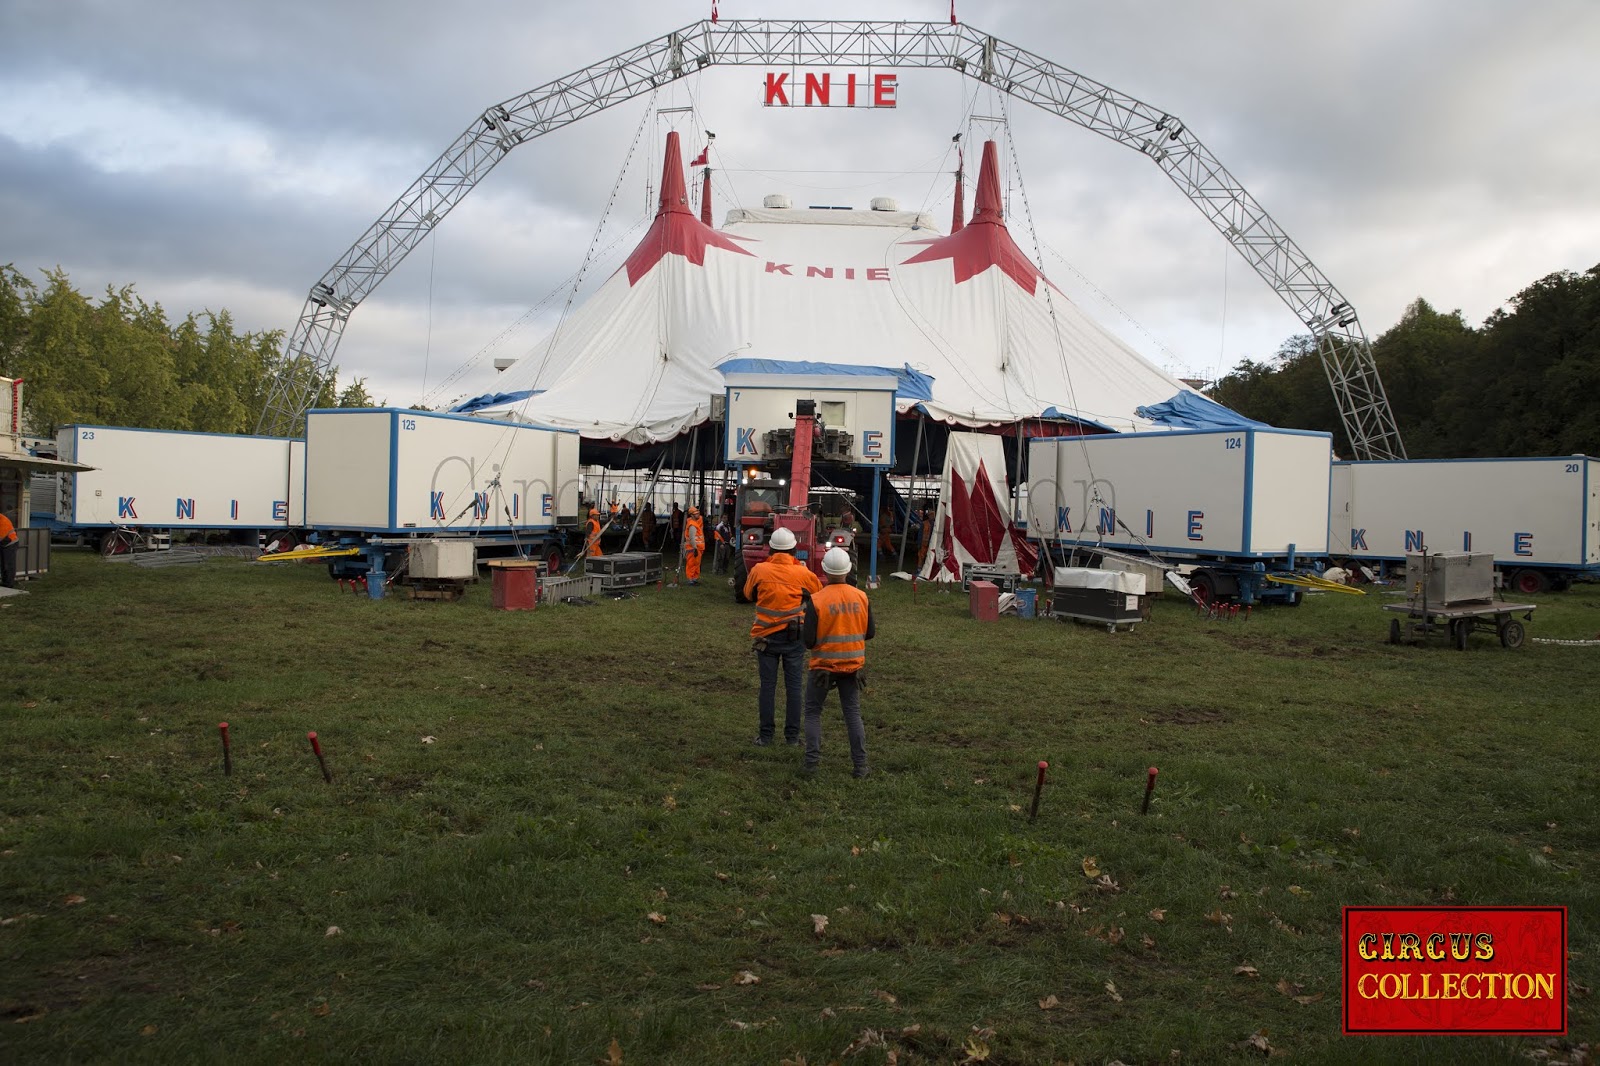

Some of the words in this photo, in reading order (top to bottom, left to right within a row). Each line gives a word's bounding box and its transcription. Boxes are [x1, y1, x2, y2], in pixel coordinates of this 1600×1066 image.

[766, 73, 896, 106] KNIE
[765, 262, 891, 281] KNIE
[734, 392, 741, 401] 7
[401, 418, 416, 431] 125
[82, 431, 95, 440] 23
[1224, 437, 1242, 450] 124
[1565, 463, 1579, 473] 20
[118, 496, 288, 520] KNIE
[430, 491, 553, 520] KNIE
[1057, 506, 1204, 541] KNIE
[1351, 528, 1533, 557] KNIE
[829, 602, 860, 615] KNIE
